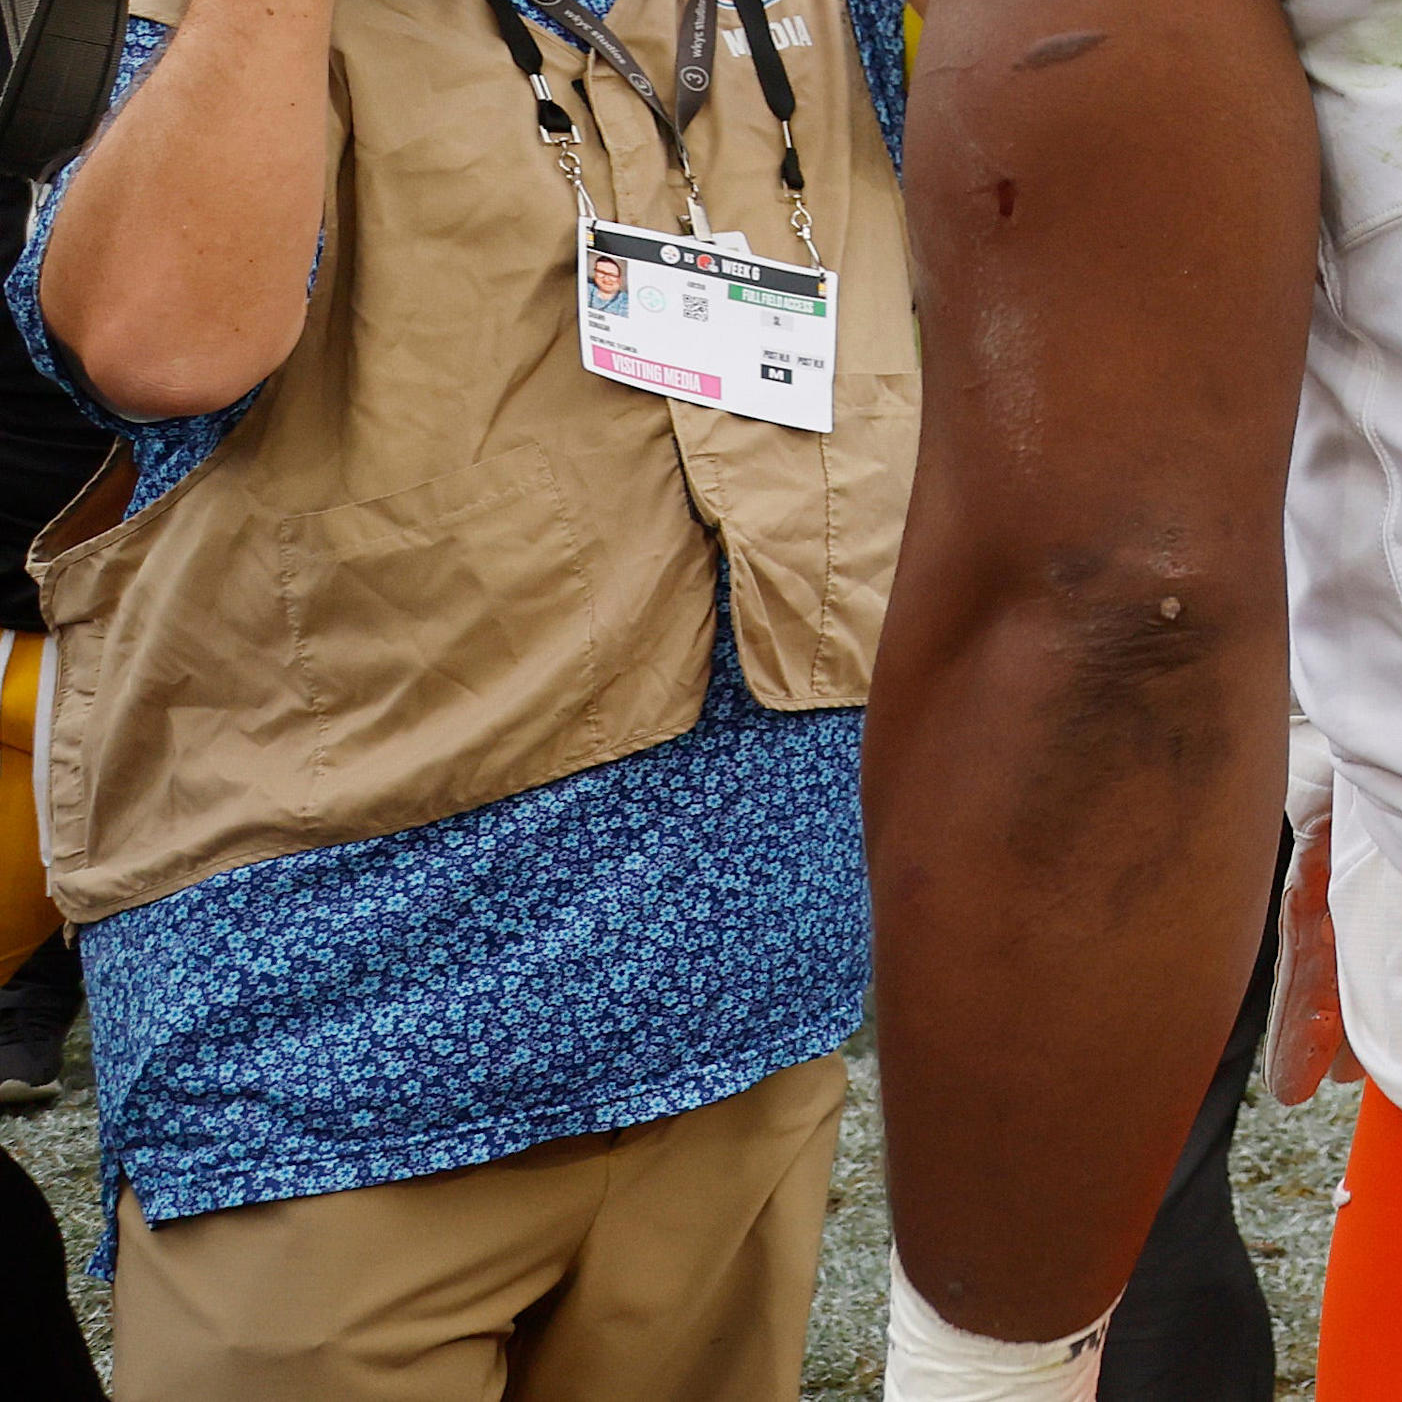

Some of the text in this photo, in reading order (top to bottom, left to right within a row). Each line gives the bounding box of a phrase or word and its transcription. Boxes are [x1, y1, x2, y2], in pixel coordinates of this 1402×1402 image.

[564, 9, 593, 31] wkyc
[591, 30, 627, 65] studios
[690, 30, 707, 59] wkyc
[721, 14, 813, 58] MDIA
[721, 259, 751, 279] WEEK
[751, 267, 760, 281] 6
[611, 352, 702, 394] VISITING MEDIA
[768, 367, 785, 381] M
